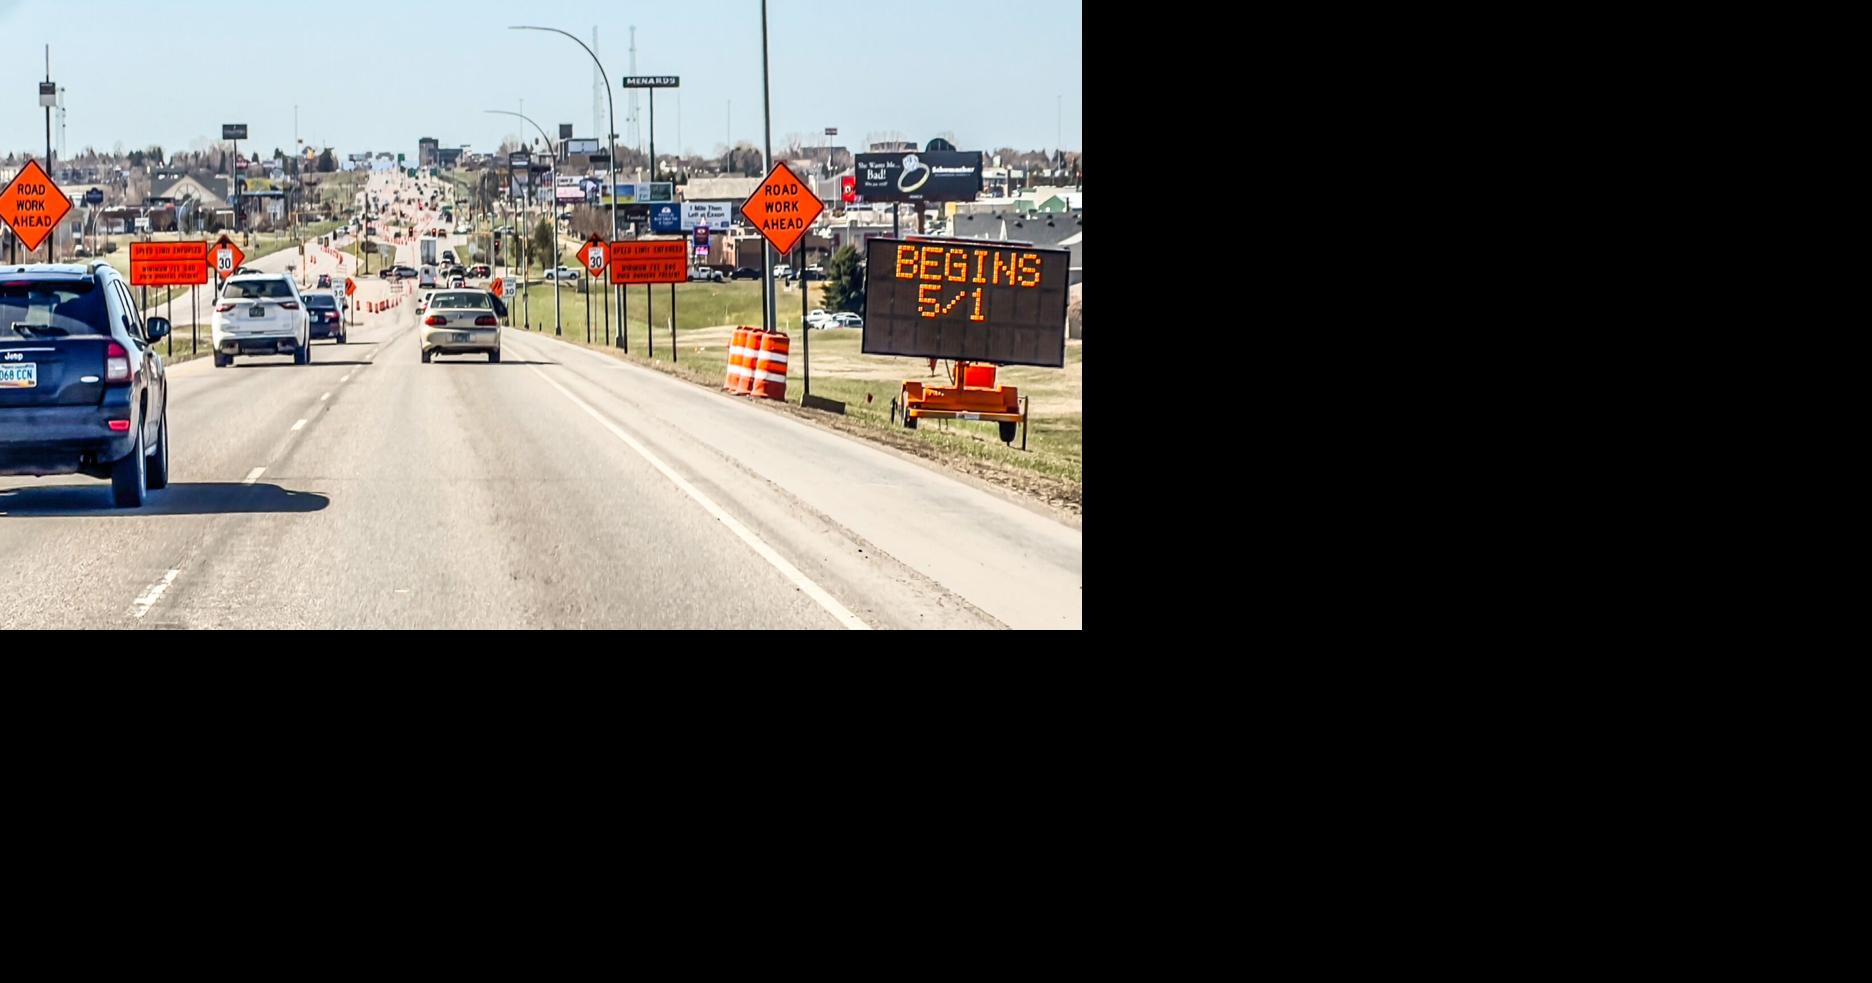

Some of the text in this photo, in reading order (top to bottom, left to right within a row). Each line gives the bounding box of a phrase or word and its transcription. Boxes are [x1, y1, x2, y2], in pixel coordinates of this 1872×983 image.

[867, 169, 886, 180] Bad!
[17, 183, 46, 196] ROAD
[765, 183, 798, 196] ROAD
[16, 199, 45, 211] WORK
[765, 201, 799, 213] WORK
[13, 215, 52, 228] AHEAD
[762, 218, 803, 231] AHEAD
[218, 257, 231, 270] 30
[590, 256, 602, 268] 30
[895, 245, 1042, 287] BEGINS
[917, 283, 985, 321] 5/1
[4, 352, 24, 361] Jeep
[16, 369, 33, 380] CCN
